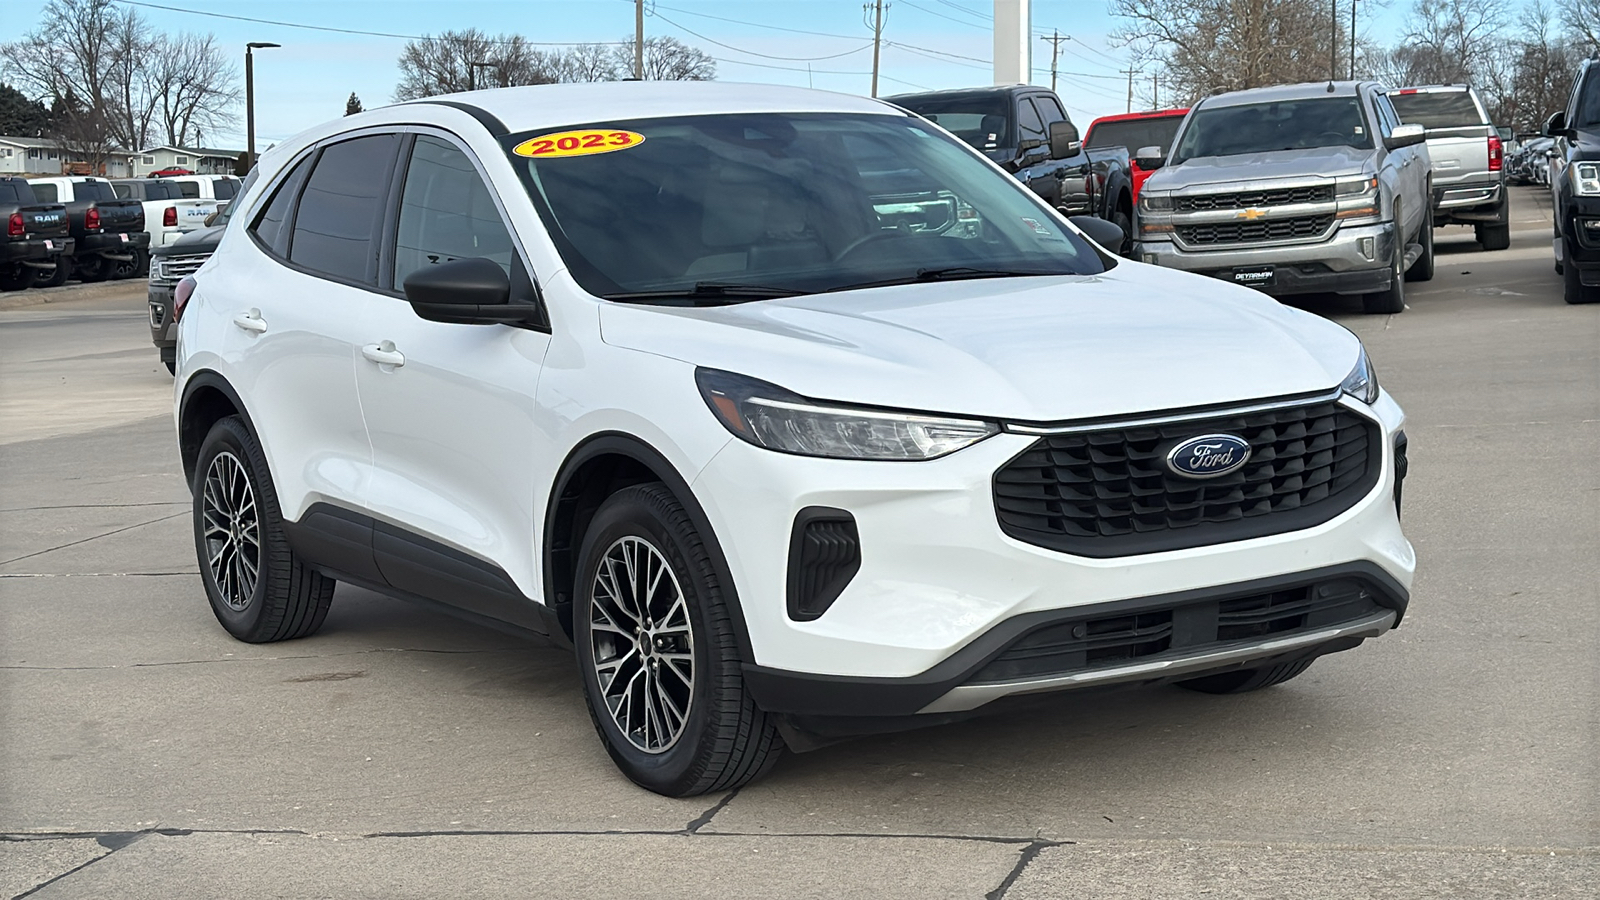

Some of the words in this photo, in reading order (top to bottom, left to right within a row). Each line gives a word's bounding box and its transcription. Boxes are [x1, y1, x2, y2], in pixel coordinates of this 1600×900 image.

[531, 132, 633, 155] 2023
[34, 215, 59, 223] RAM
[1189, 443, 1234, 470] Ford
